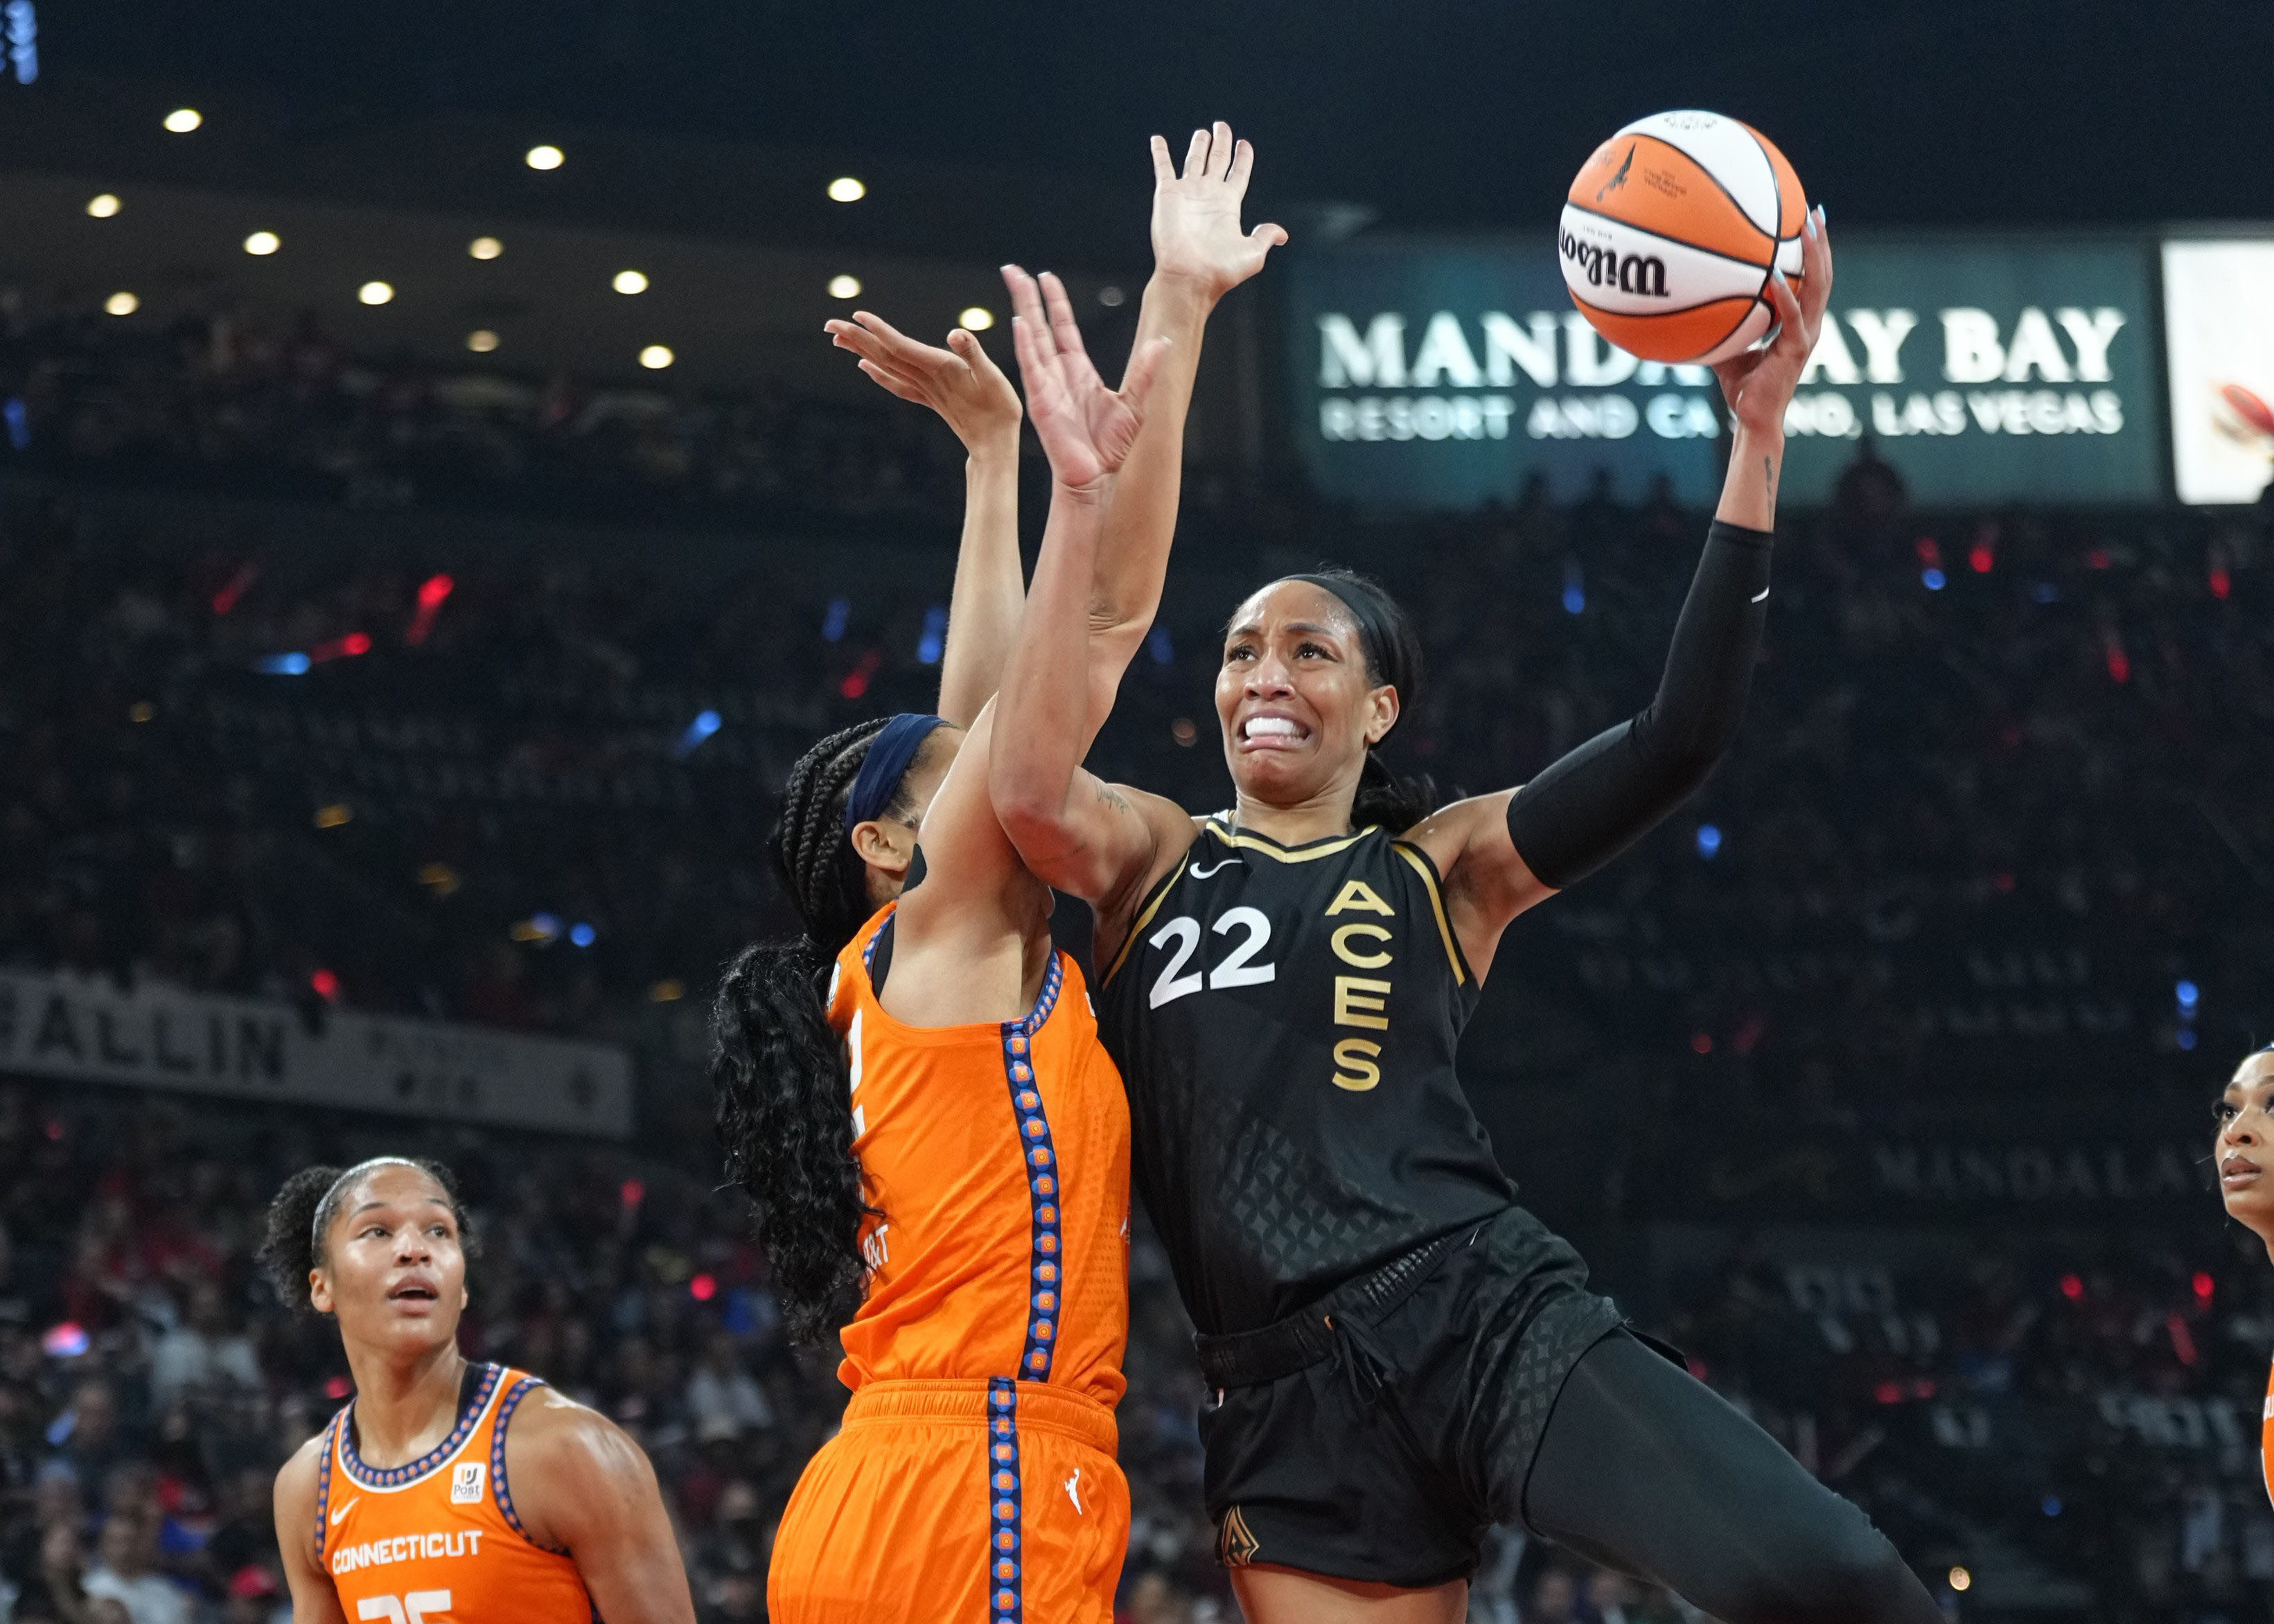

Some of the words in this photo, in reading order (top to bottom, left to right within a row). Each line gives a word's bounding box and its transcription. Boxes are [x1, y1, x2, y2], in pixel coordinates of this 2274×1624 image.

[1560, 225, 1671, 297] Wilson
[1319, 310, 1919, 387] MANDAY
[1941, 307, 2127, 382] BAY
[1320, 395, 1516, 441] RESORT
[1527, 394, 1639, 439] AND
[1872, 390, 1966, 436] LAS
[1966, 388, 2124, 435] VEGAS
[1149, 906, 1276, 1010] 22
[1324, 880, 1395, 1092] ACES
[333, 1530, 483, 1575] CONNECTICUT
